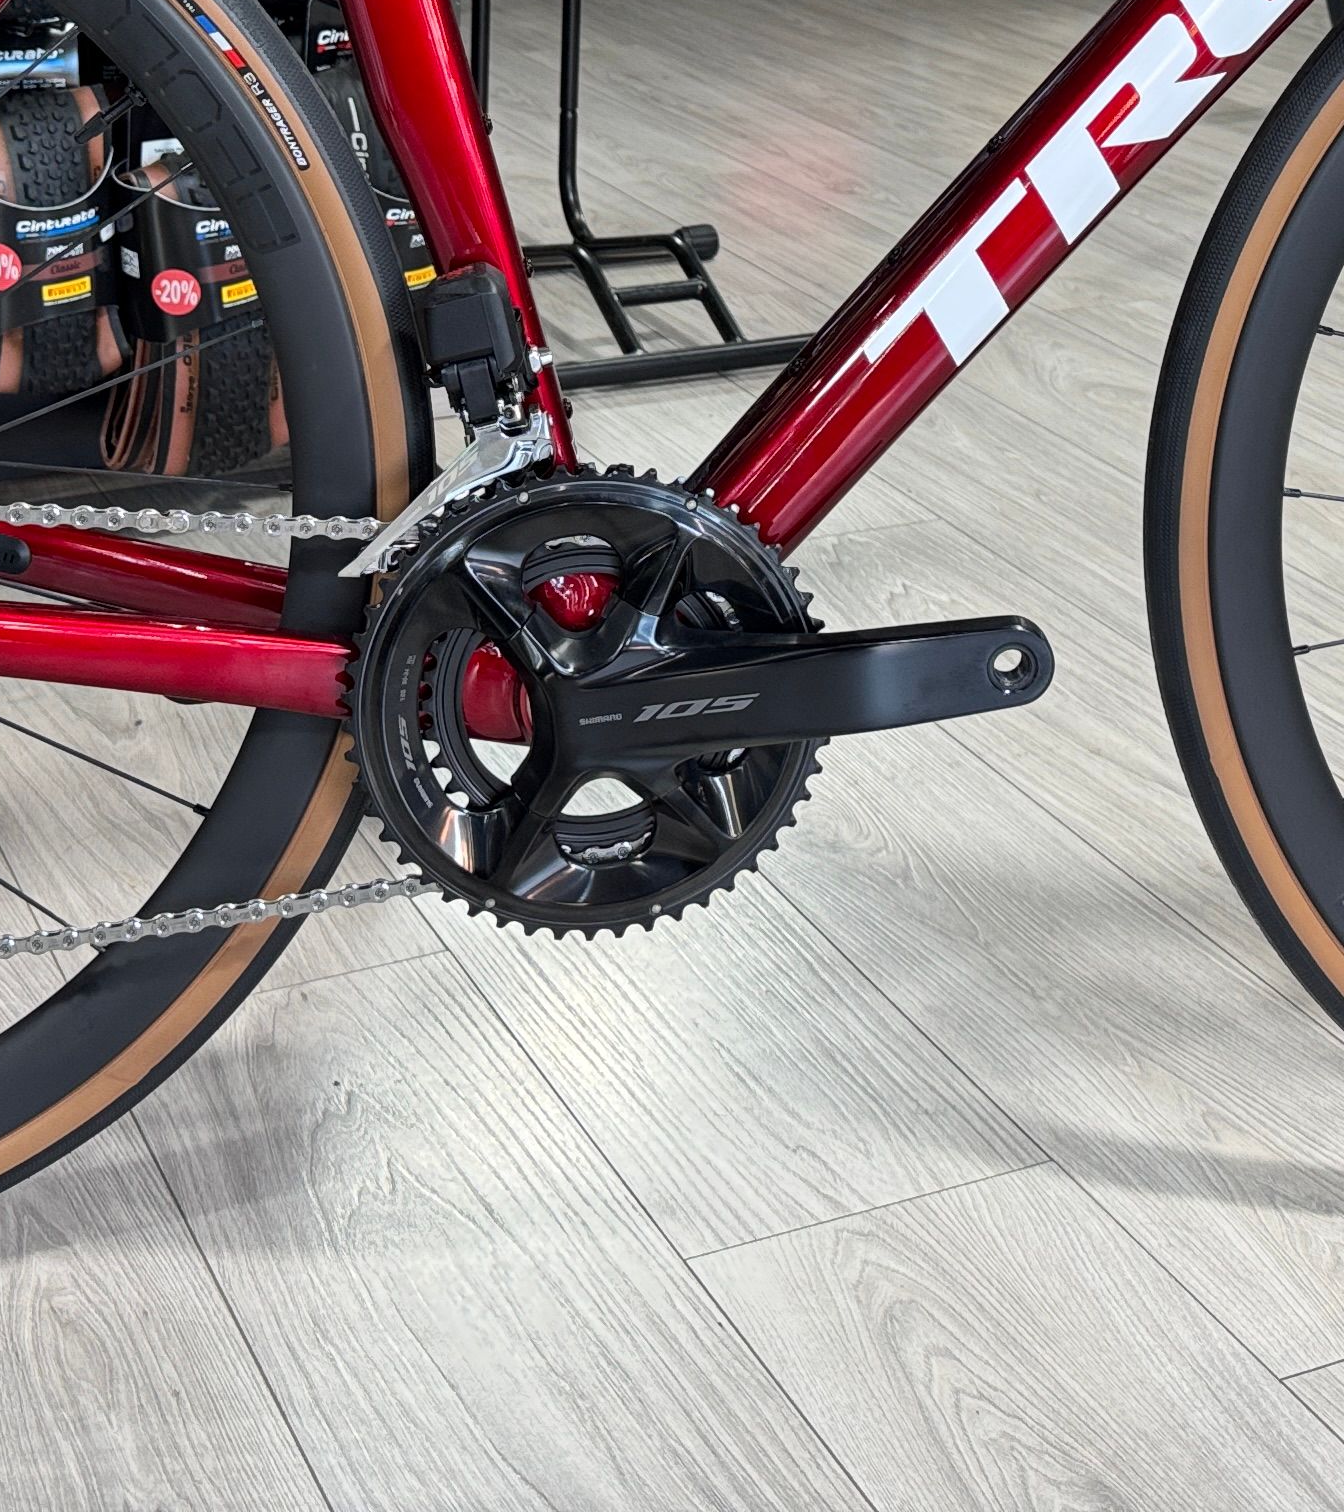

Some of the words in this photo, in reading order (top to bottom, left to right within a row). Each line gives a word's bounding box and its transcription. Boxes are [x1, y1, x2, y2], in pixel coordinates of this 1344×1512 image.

[244, 71, 266, 98] R3
[261, 96, 309, 168] BONTRAGER
[16, 208, 97, 234] Cinturato
[47, 281, 88, 297] PIRELLI
[154, 278, 200, 308] -20%
[579, 713, 623, 726] SHIMANO
[633, 692, 762, 725] 105
[398, 714, 417, 773] 105
